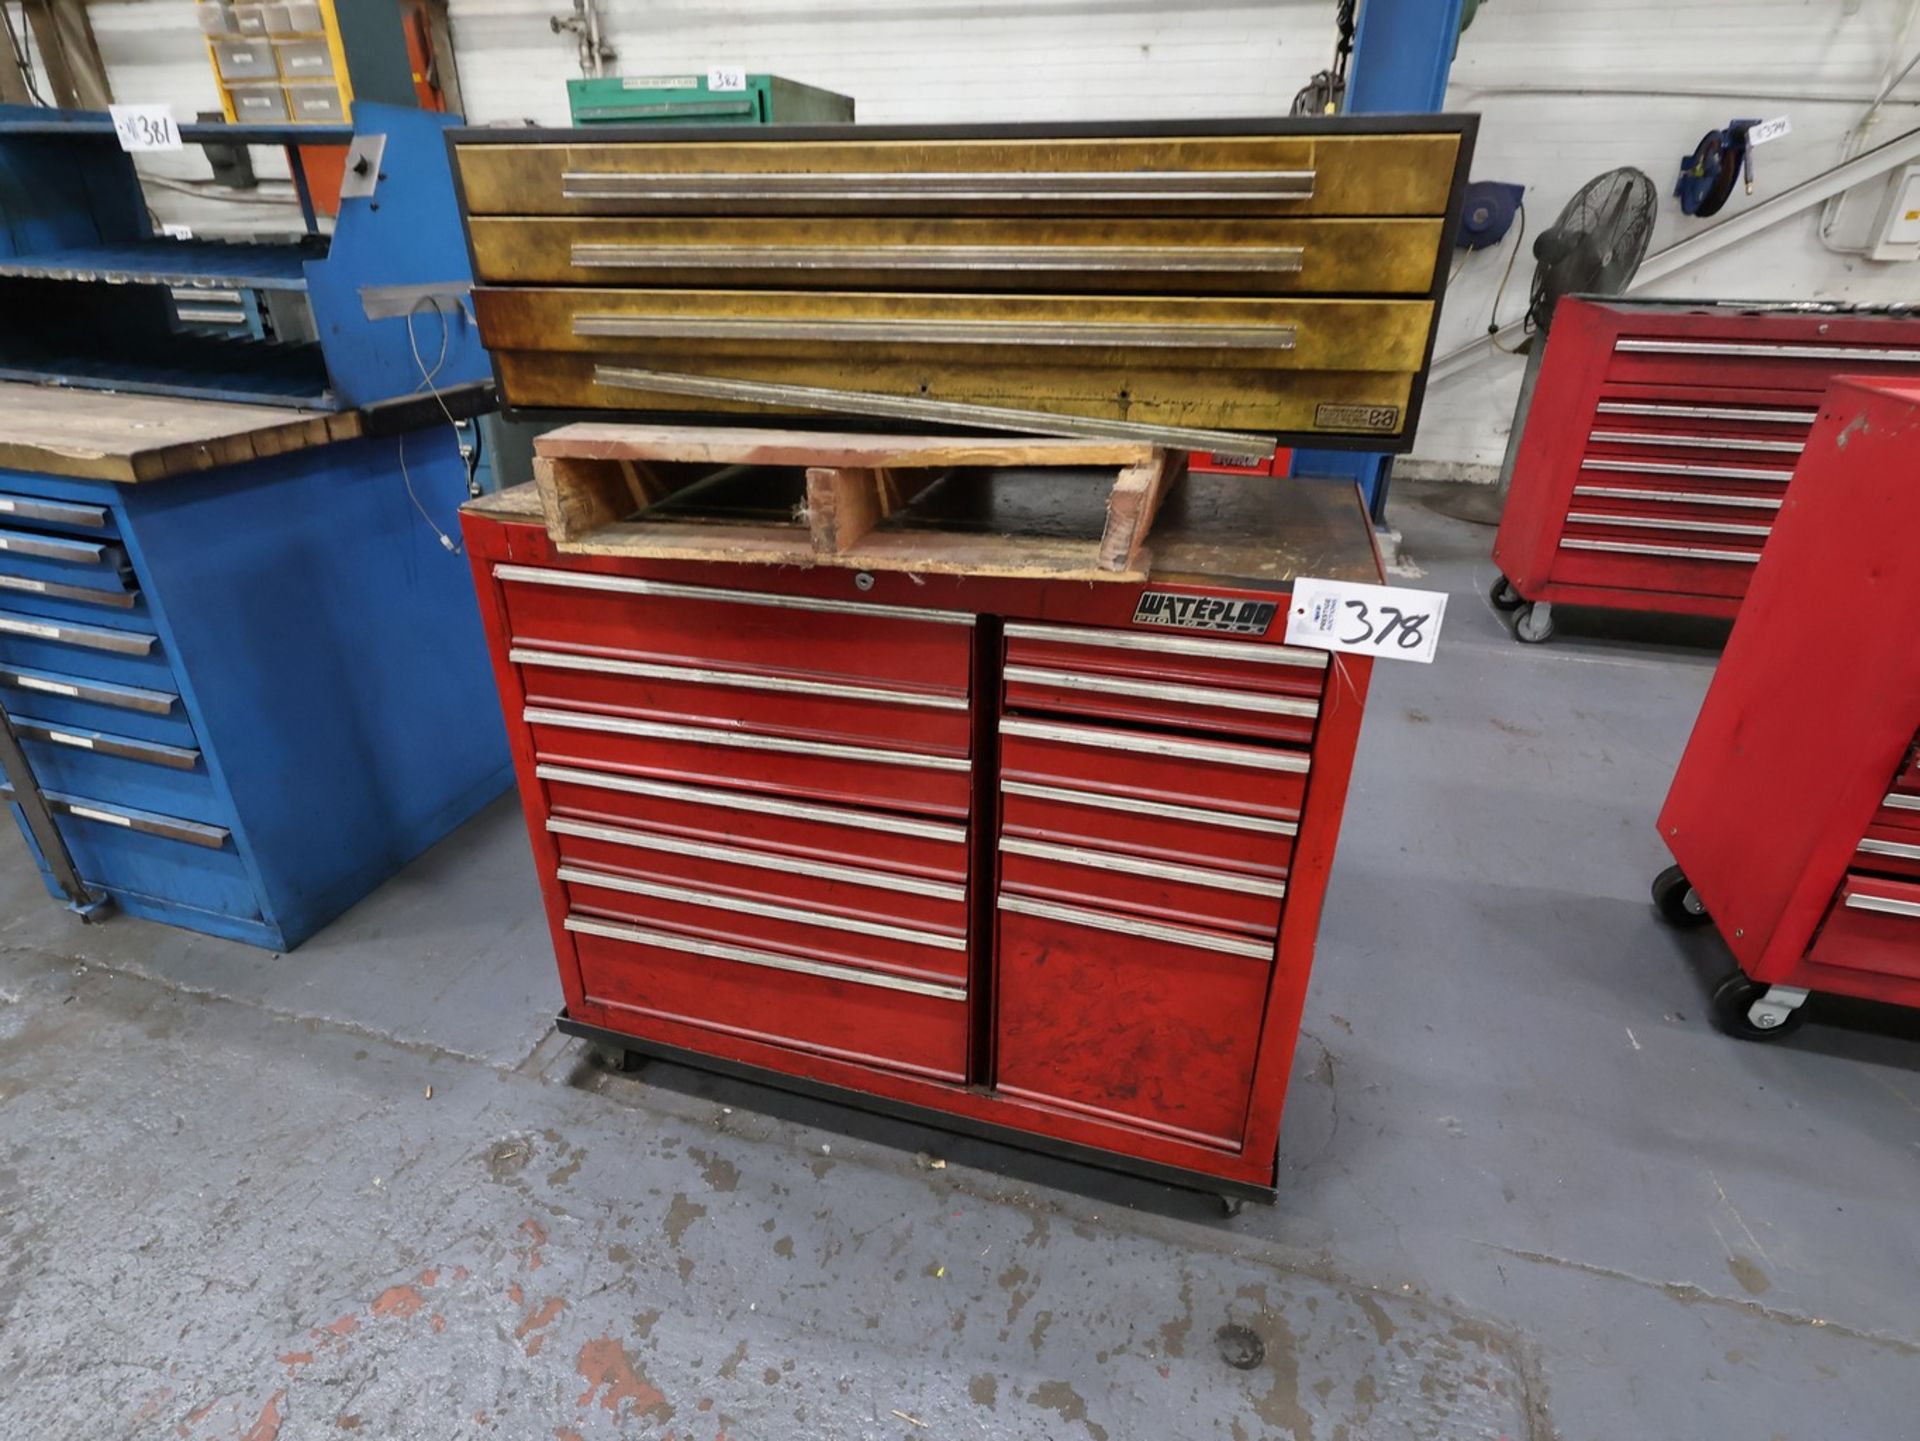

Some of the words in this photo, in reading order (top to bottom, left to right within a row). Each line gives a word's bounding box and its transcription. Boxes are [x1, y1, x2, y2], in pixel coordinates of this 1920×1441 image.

[715, 70, 739, 89] 382
[137, 115, 172, 146] 381
[1137, 592, 1277, 626] WATERLOO
[1340, 600, 1431, 649] 378
